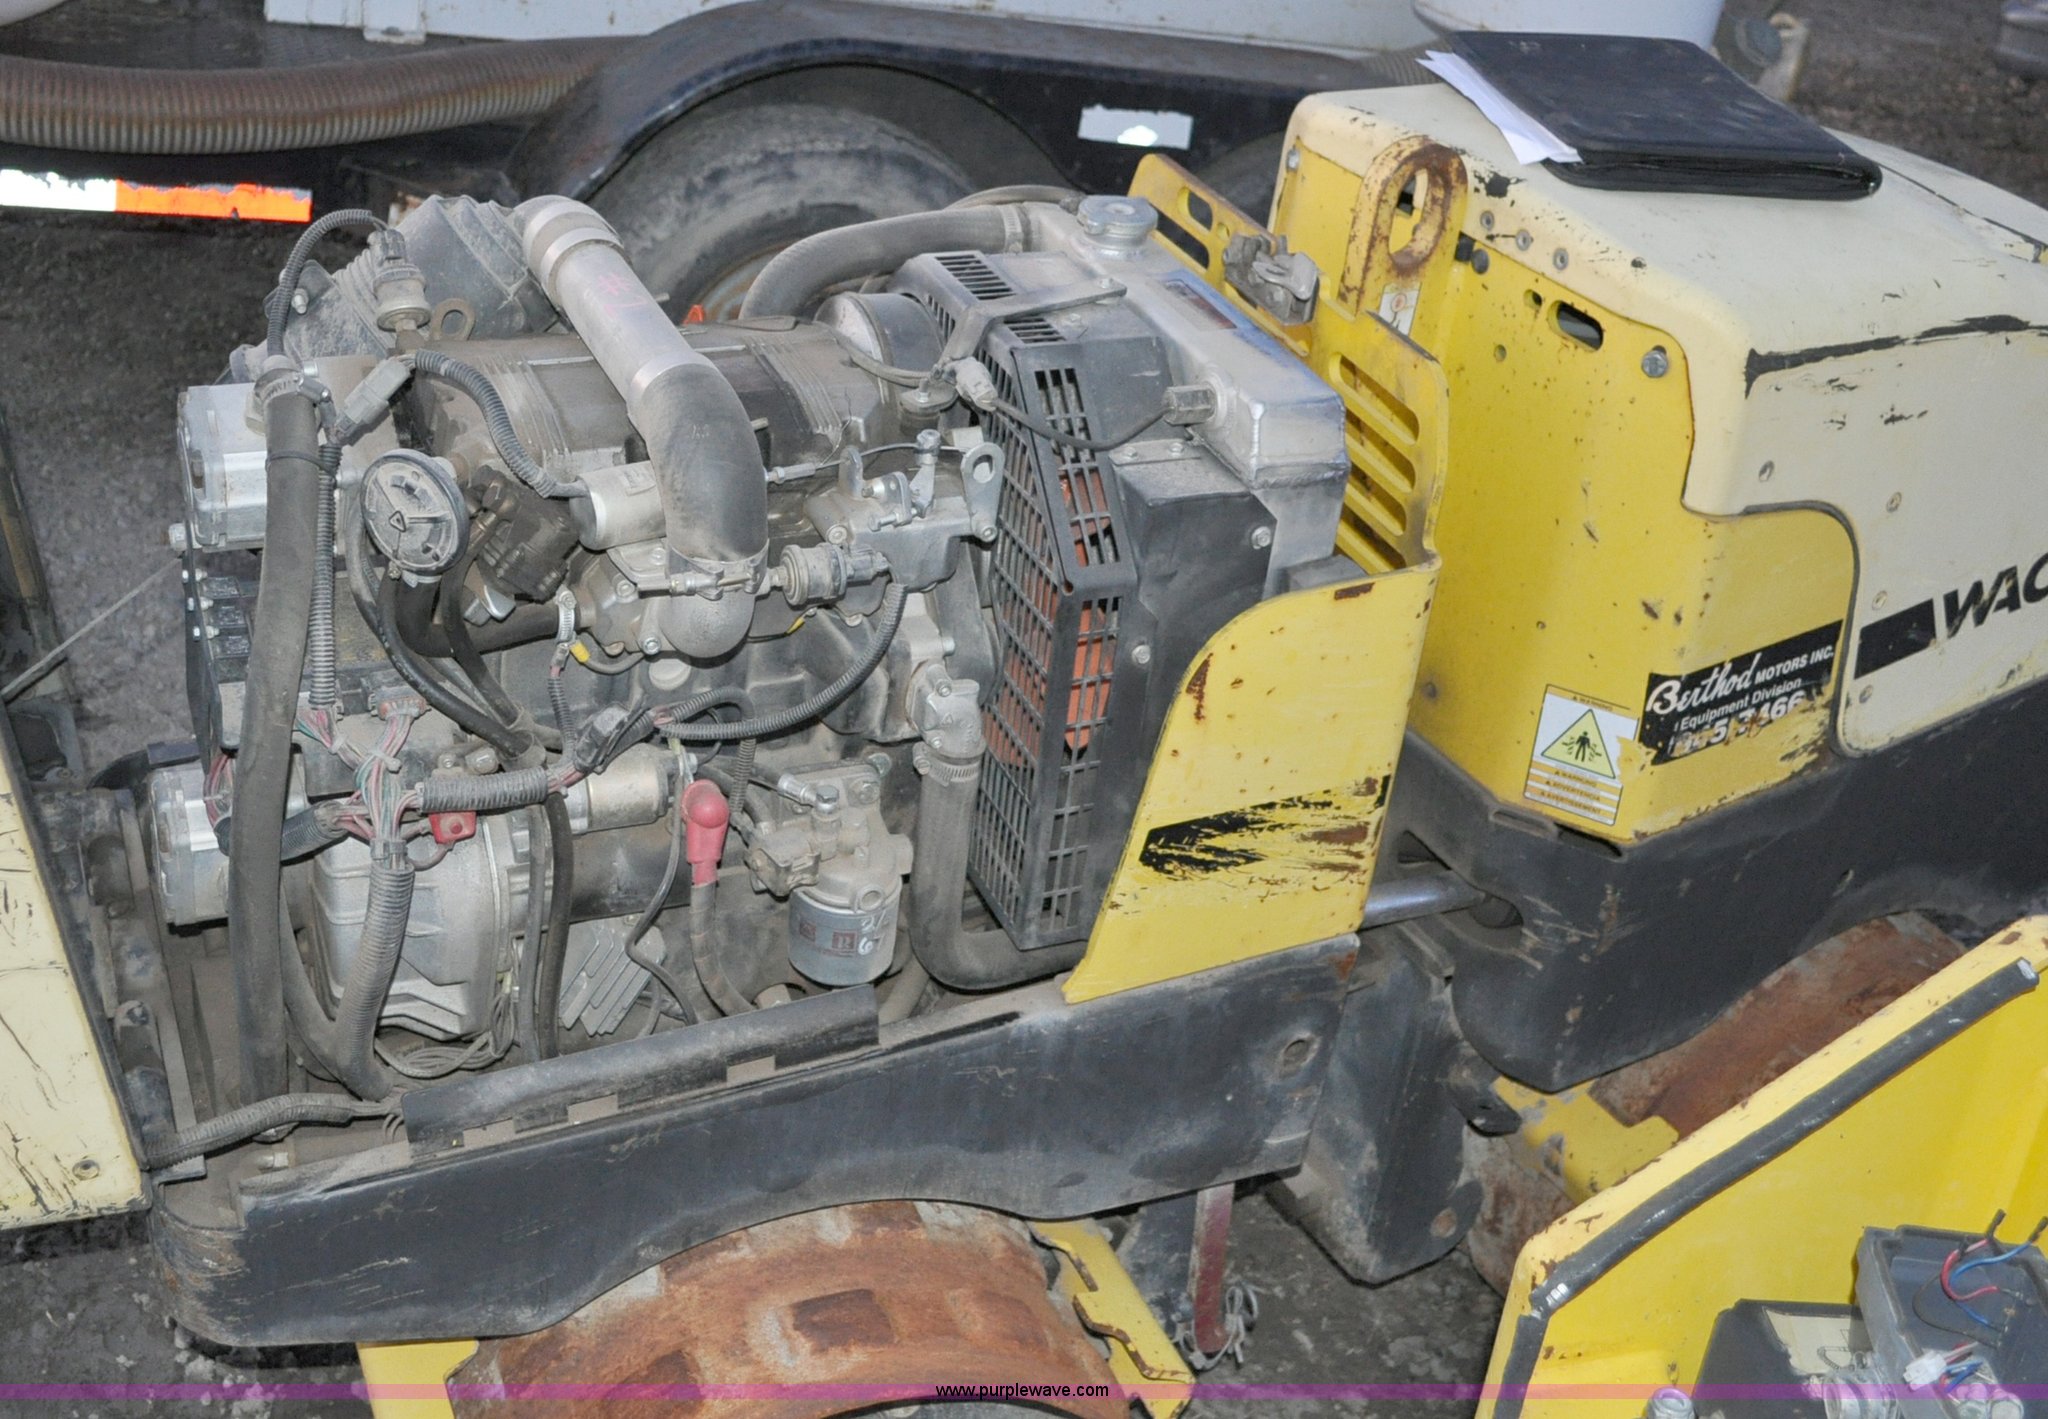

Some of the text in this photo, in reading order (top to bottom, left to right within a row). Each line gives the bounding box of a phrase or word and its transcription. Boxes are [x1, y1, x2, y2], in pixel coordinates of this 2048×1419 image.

[1647, 646, 1835, 714] Berthod MOTORS INC.
[1680, 678, 1802, 730] Equipment Division
